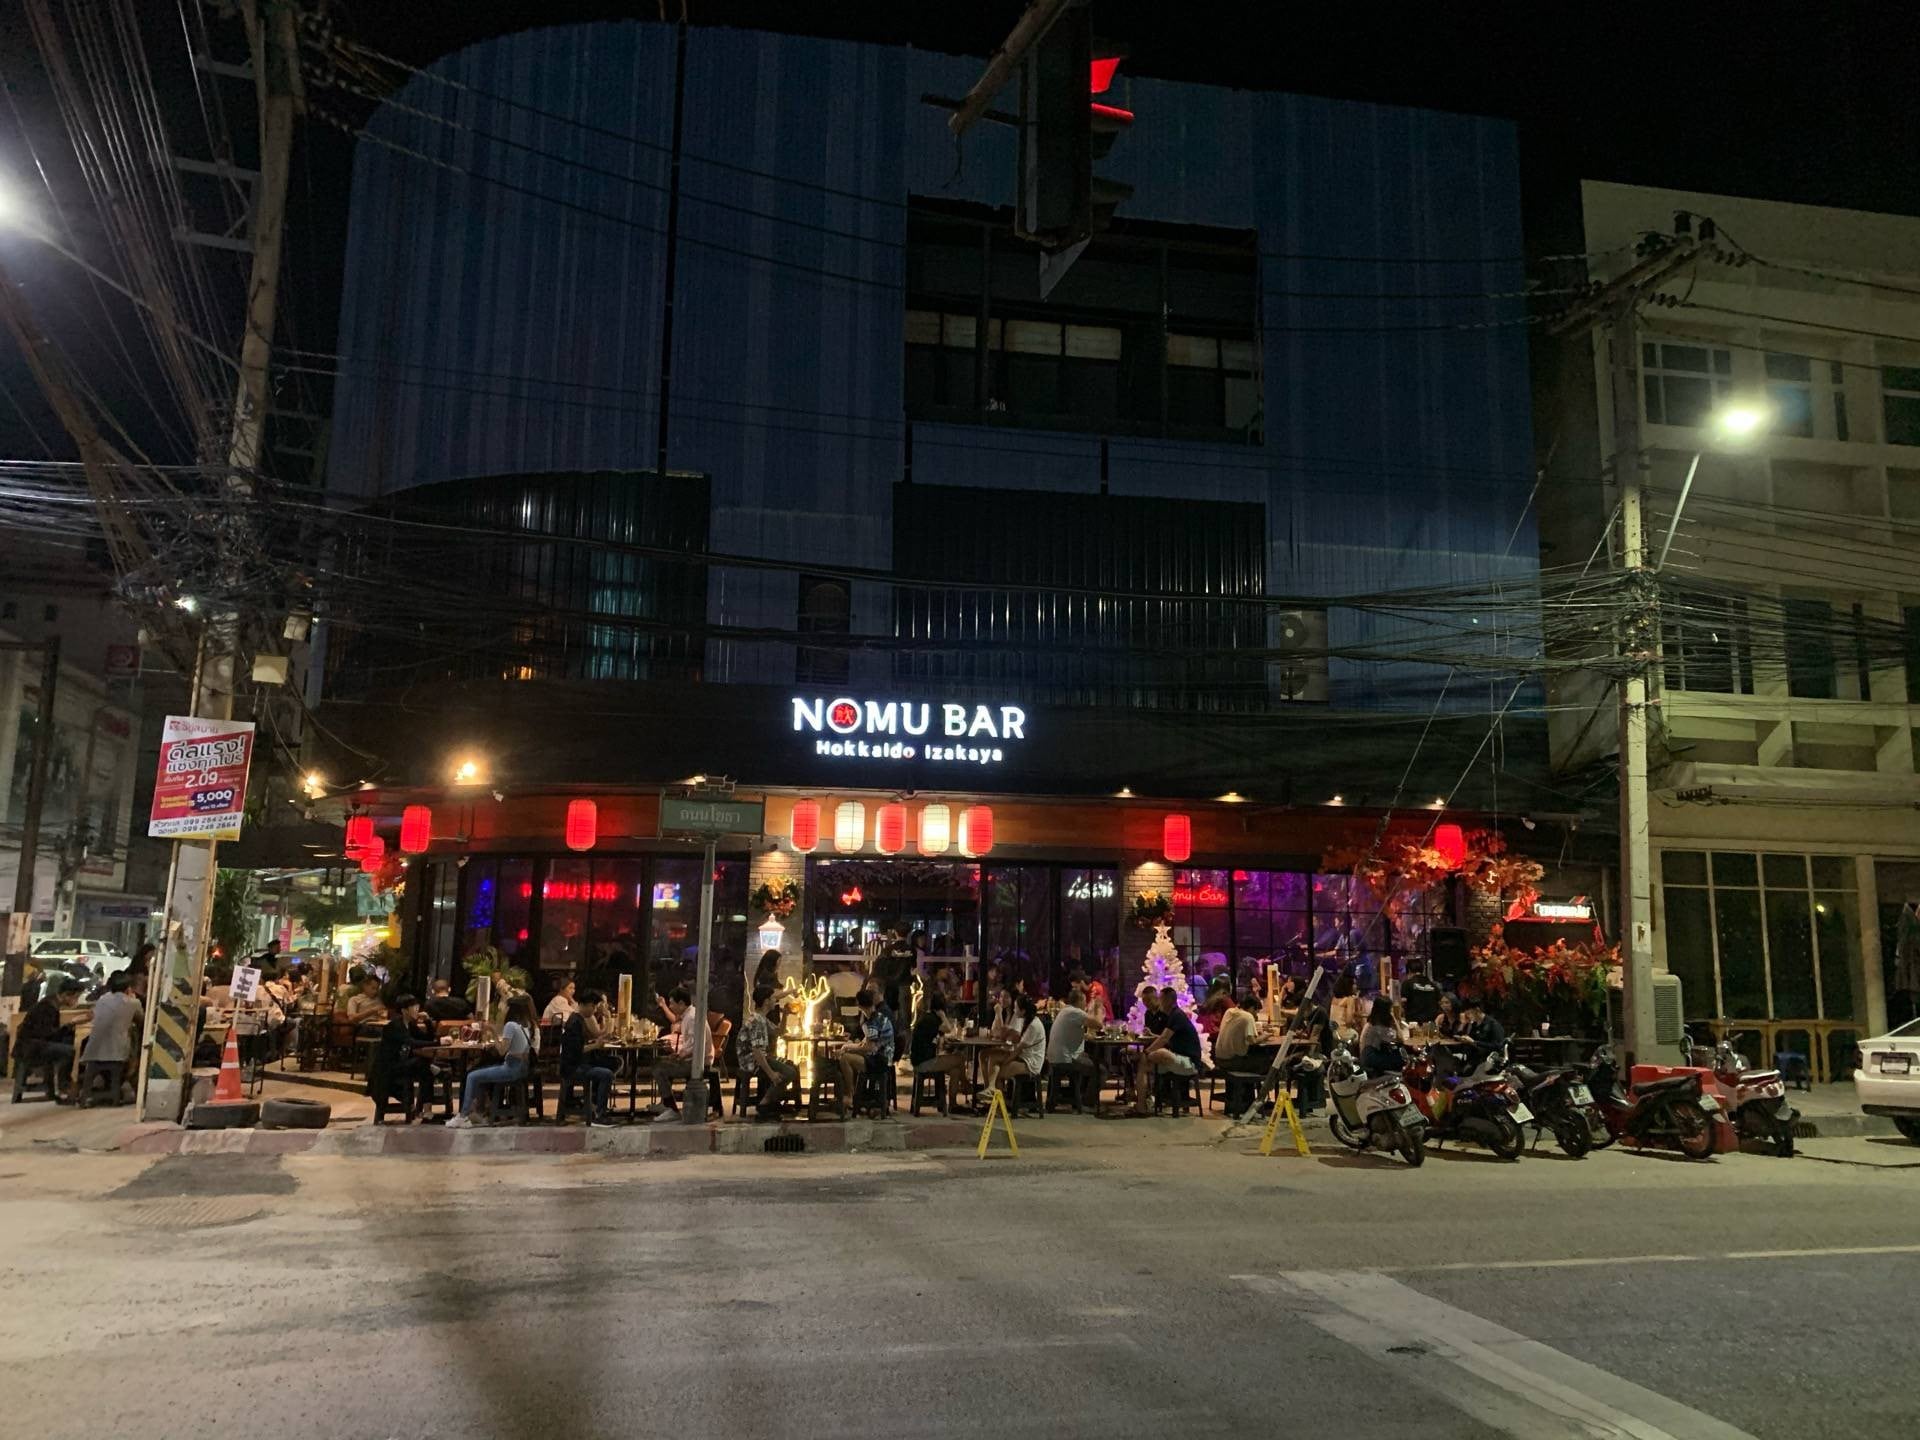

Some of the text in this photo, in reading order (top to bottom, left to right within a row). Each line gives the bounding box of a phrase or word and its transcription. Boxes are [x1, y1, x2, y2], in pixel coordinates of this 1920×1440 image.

[791, 697, 1026, 739] NOMU BAR
[169, 736, 245, 760] ดีลแรง!
[816, 740, 1003, 765] Hokkaido Izakaya
[185, 771, 218, 788] 2.09
[196, 789, 233, 803] 5,000
